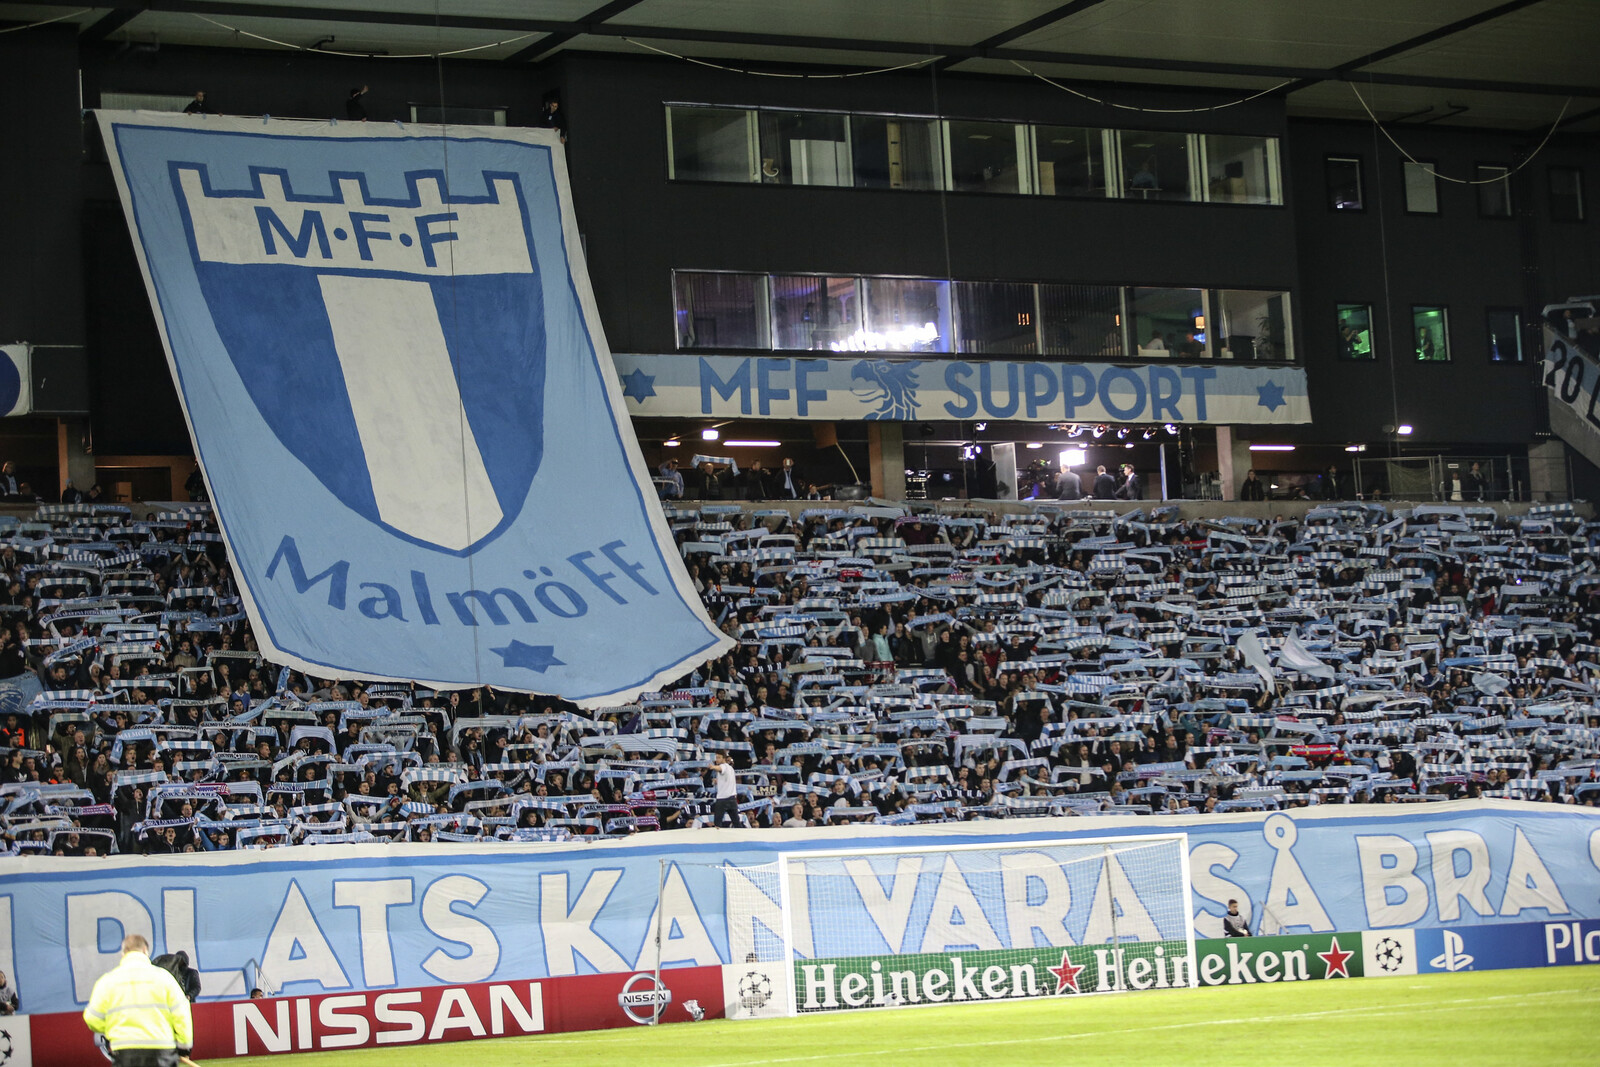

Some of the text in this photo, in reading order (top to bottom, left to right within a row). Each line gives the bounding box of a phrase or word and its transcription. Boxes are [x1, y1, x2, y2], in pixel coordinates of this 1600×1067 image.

[699, 356, 1217, 421] MFF SUPPORT
[65, 873, 502, 1006] PLATS
[538, 858, 817, 978] KAN
[842, 846, 1164, 955] VARA
[1188, 812, 1337, 939] SÅ
[1354, 824, 1572, 930] BRA
[800, 957, 1040, 1010] Heineken
[1093, 943, 1311, 992] Heineken
[232, 982, 545, 1056] NISSAN
[623, 993, 667, 1004] NISSAN
